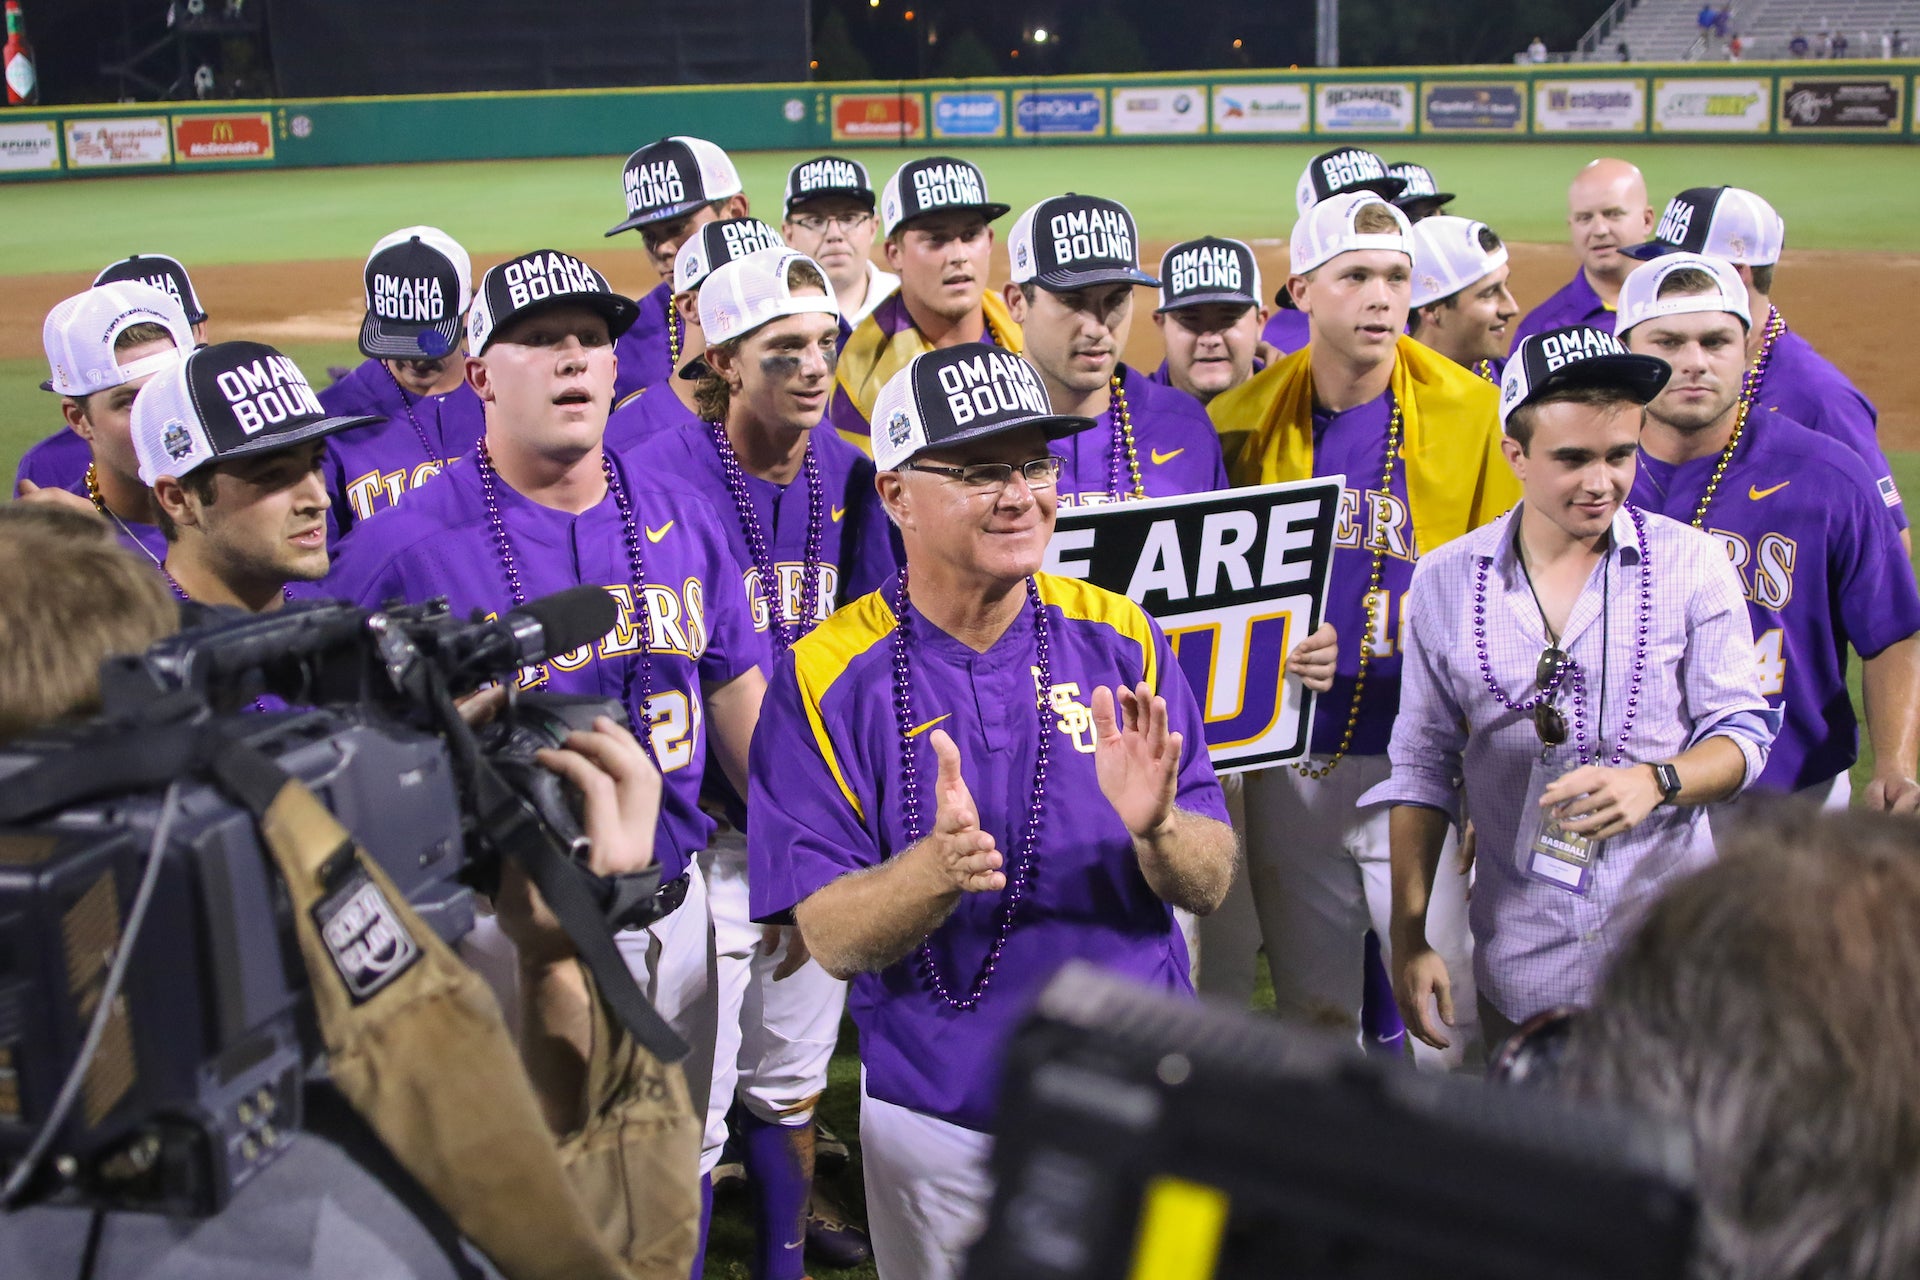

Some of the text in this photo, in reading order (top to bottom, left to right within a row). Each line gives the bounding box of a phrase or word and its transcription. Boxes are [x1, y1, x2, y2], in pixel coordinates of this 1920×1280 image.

[625, 160, 680, 192] OMAHA
[800, 160, 857, 181] OMAHA
[913, 164, 978, 189] OMAHA
[1322, 150, 1380, 174] OMAHA
[1387, 165, 1431, 181] MAHA
[626, 180, 685, 213] BOUND
[917, 182, 982, 210] BOUND
[1399, 178, 1435, 197] UND
[1051, 208, 1129, 239] OMAHA
[1664, 197, 1695, 226] AHA
[1655, 216, 1689, 246] UND
[1054, 231, 1132, 264] BOUND
[1171, 246, 1240, 274] OMAHA
[504, 252, 597, 287] OMAHA
[1172, 265, 1242, 295] BOUND
[374, 273, 443, 299] OMAHA
[375, 296, 443, 321] BOUND
[1542, 328, 1625, 359] OMAHA
[938, 352, 1037, 396] OMAHA
[231, 383, 325, 435] BOUN
[948, 380, 1047, 426] BOUND
[1126, 499, 1322, 604] ARE
[640, 688, 703, 774] 2
[1540, 834, 1586, 858] BASEBALL
